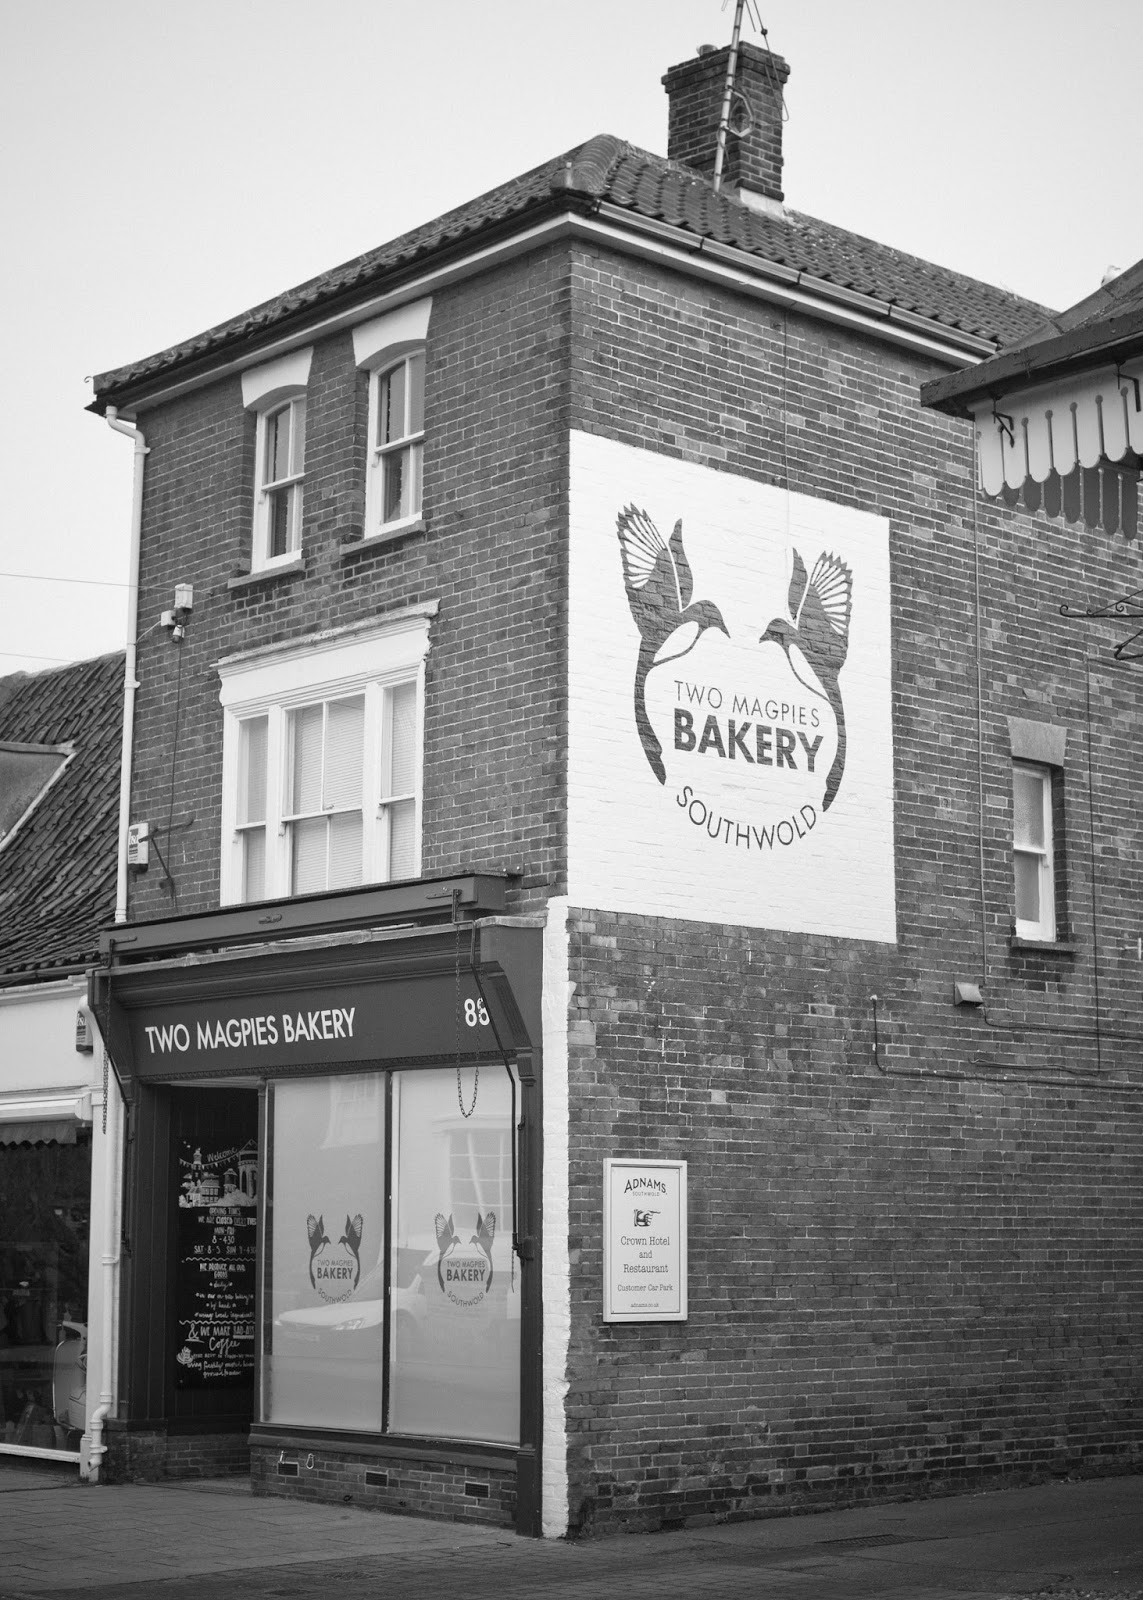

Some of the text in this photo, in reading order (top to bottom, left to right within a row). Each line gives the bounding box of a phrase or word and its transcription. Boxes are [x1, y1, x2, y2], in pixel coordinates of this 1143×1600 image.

[674, 680, 821, 728] TWO MAGPIES
[674, 707, 824, 773] BAKERY
[677, 786, 817, 850] SOUTHWOLD
[145, 1007, 357, 1053] TWO MAGPIES BAKERY
[207, 1148, 237, 1162] Welcome
[624, 1178, 666, 1194] ADNAMS
[216, 1216, 233, 1225] CLOSED
[620, 1236, 670, 1246] Crown Hotel
[638, 1250, 653, 1259] and
[318, 1259, 354, 1267] TWO MAGPIES
[446, 1260, 486, 1268] TWO MAGPIES
[623, 1264, 669, 1274] Restaurant
[317, 1267, 354, 1280] BAKERY
[446, 1268, 486, 1282] BAKERY
[618, 1284, 646, 1292] Customer
[660, 1284, 674, 1292] Park
[318, 1287, 352, 1304] SOUTHWOLD
[447, 1290, 484, 1308] SOUTHWOLD
[200, 1326, 210, 1336] WE
[213, 1326, 230, 1336] MAKE
[208, 1336, 240, 1356] Coffee
